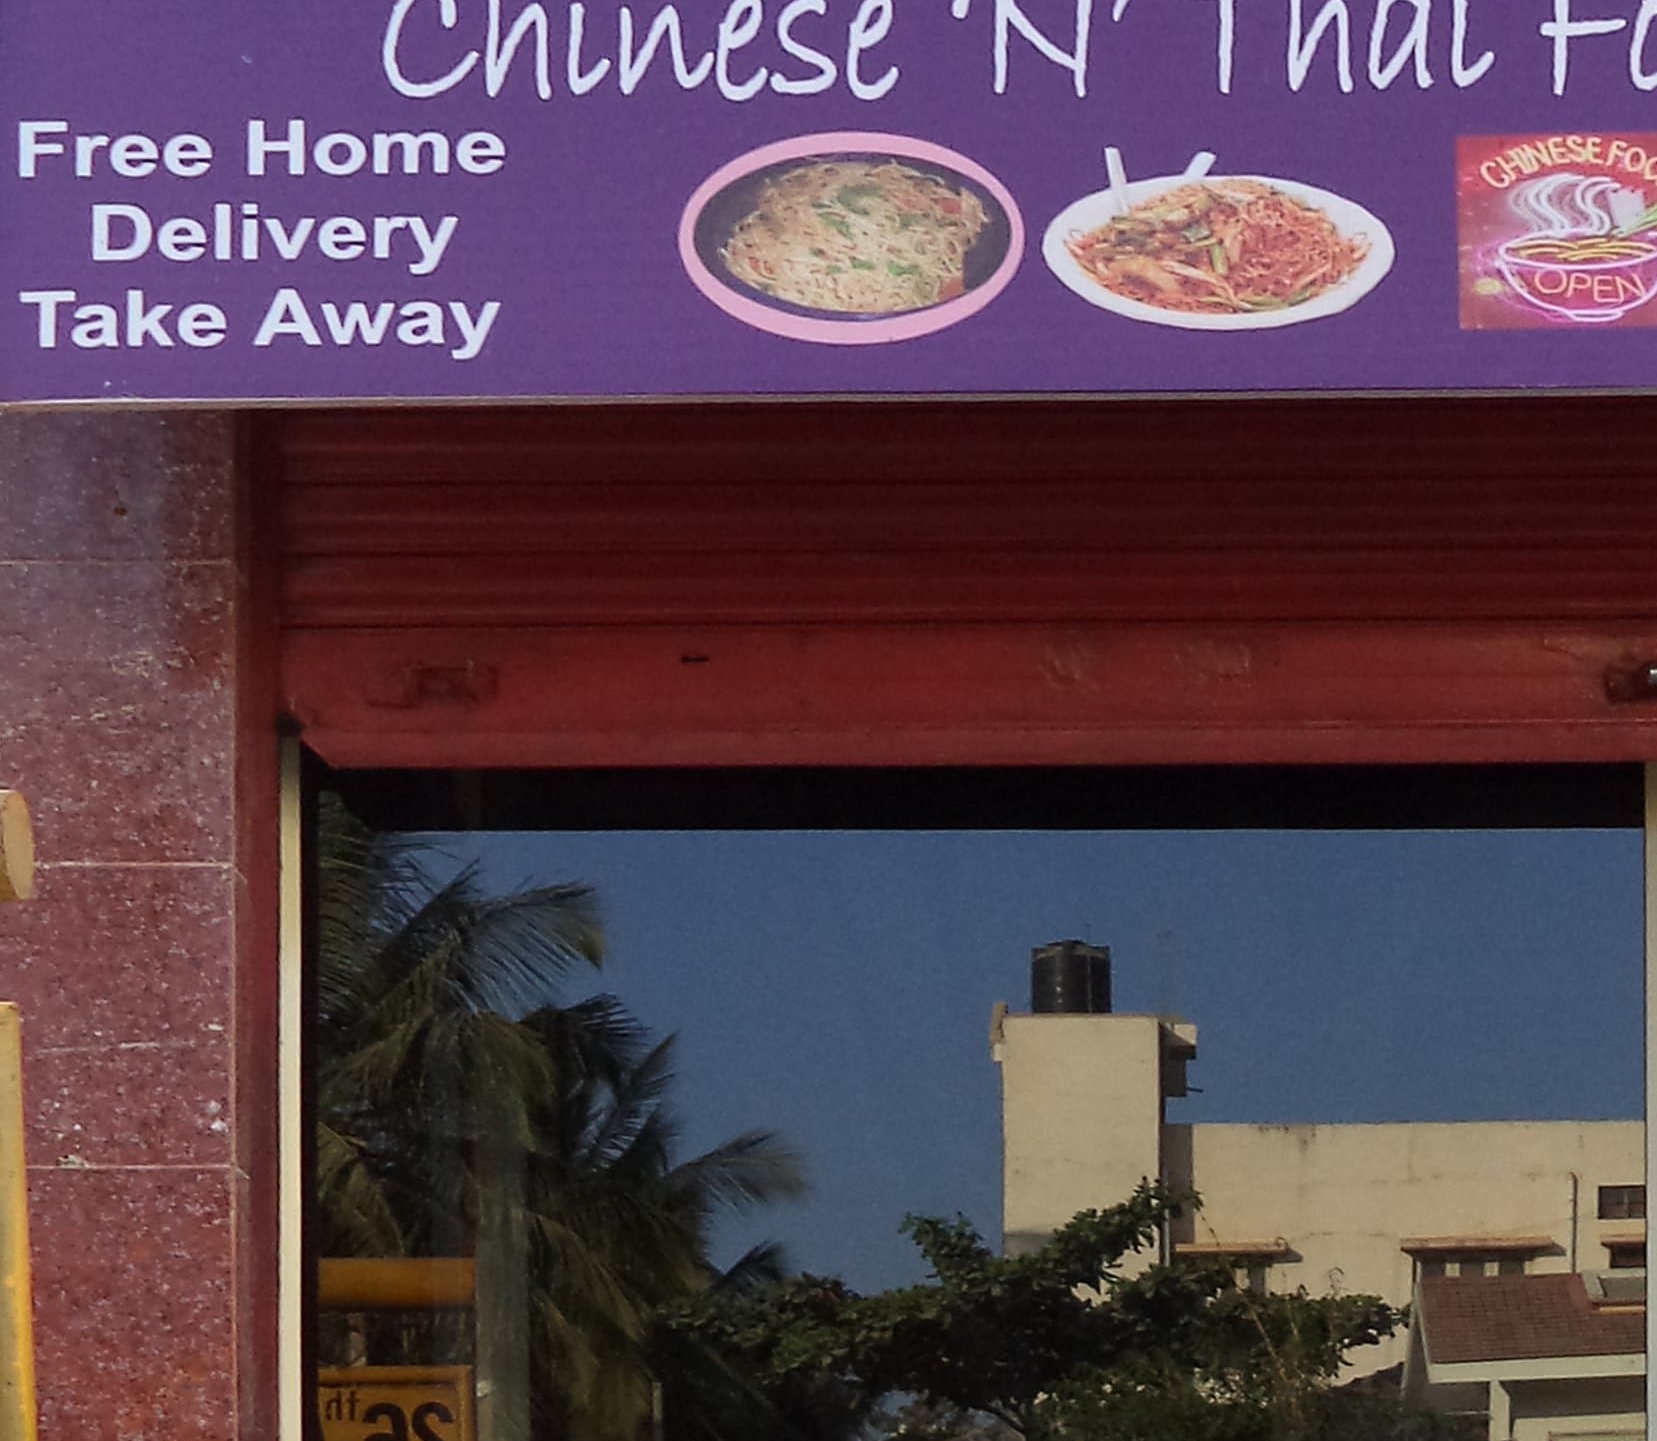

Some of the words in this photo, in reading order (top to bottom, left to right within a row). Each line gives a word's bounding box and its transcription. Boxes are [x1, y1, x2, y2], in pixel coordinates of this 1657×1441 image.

[18, 121, 213, 177] Free
[247, 120, 506, 176] Home
[1480, 134, 1604, 189] CHINESE
[92, 204, 459, 274] Delivery
[1534, 268, 1645, 303] OPEN
[19, 290, 227, 348] Take
[254, 288, 501, 361] Away
